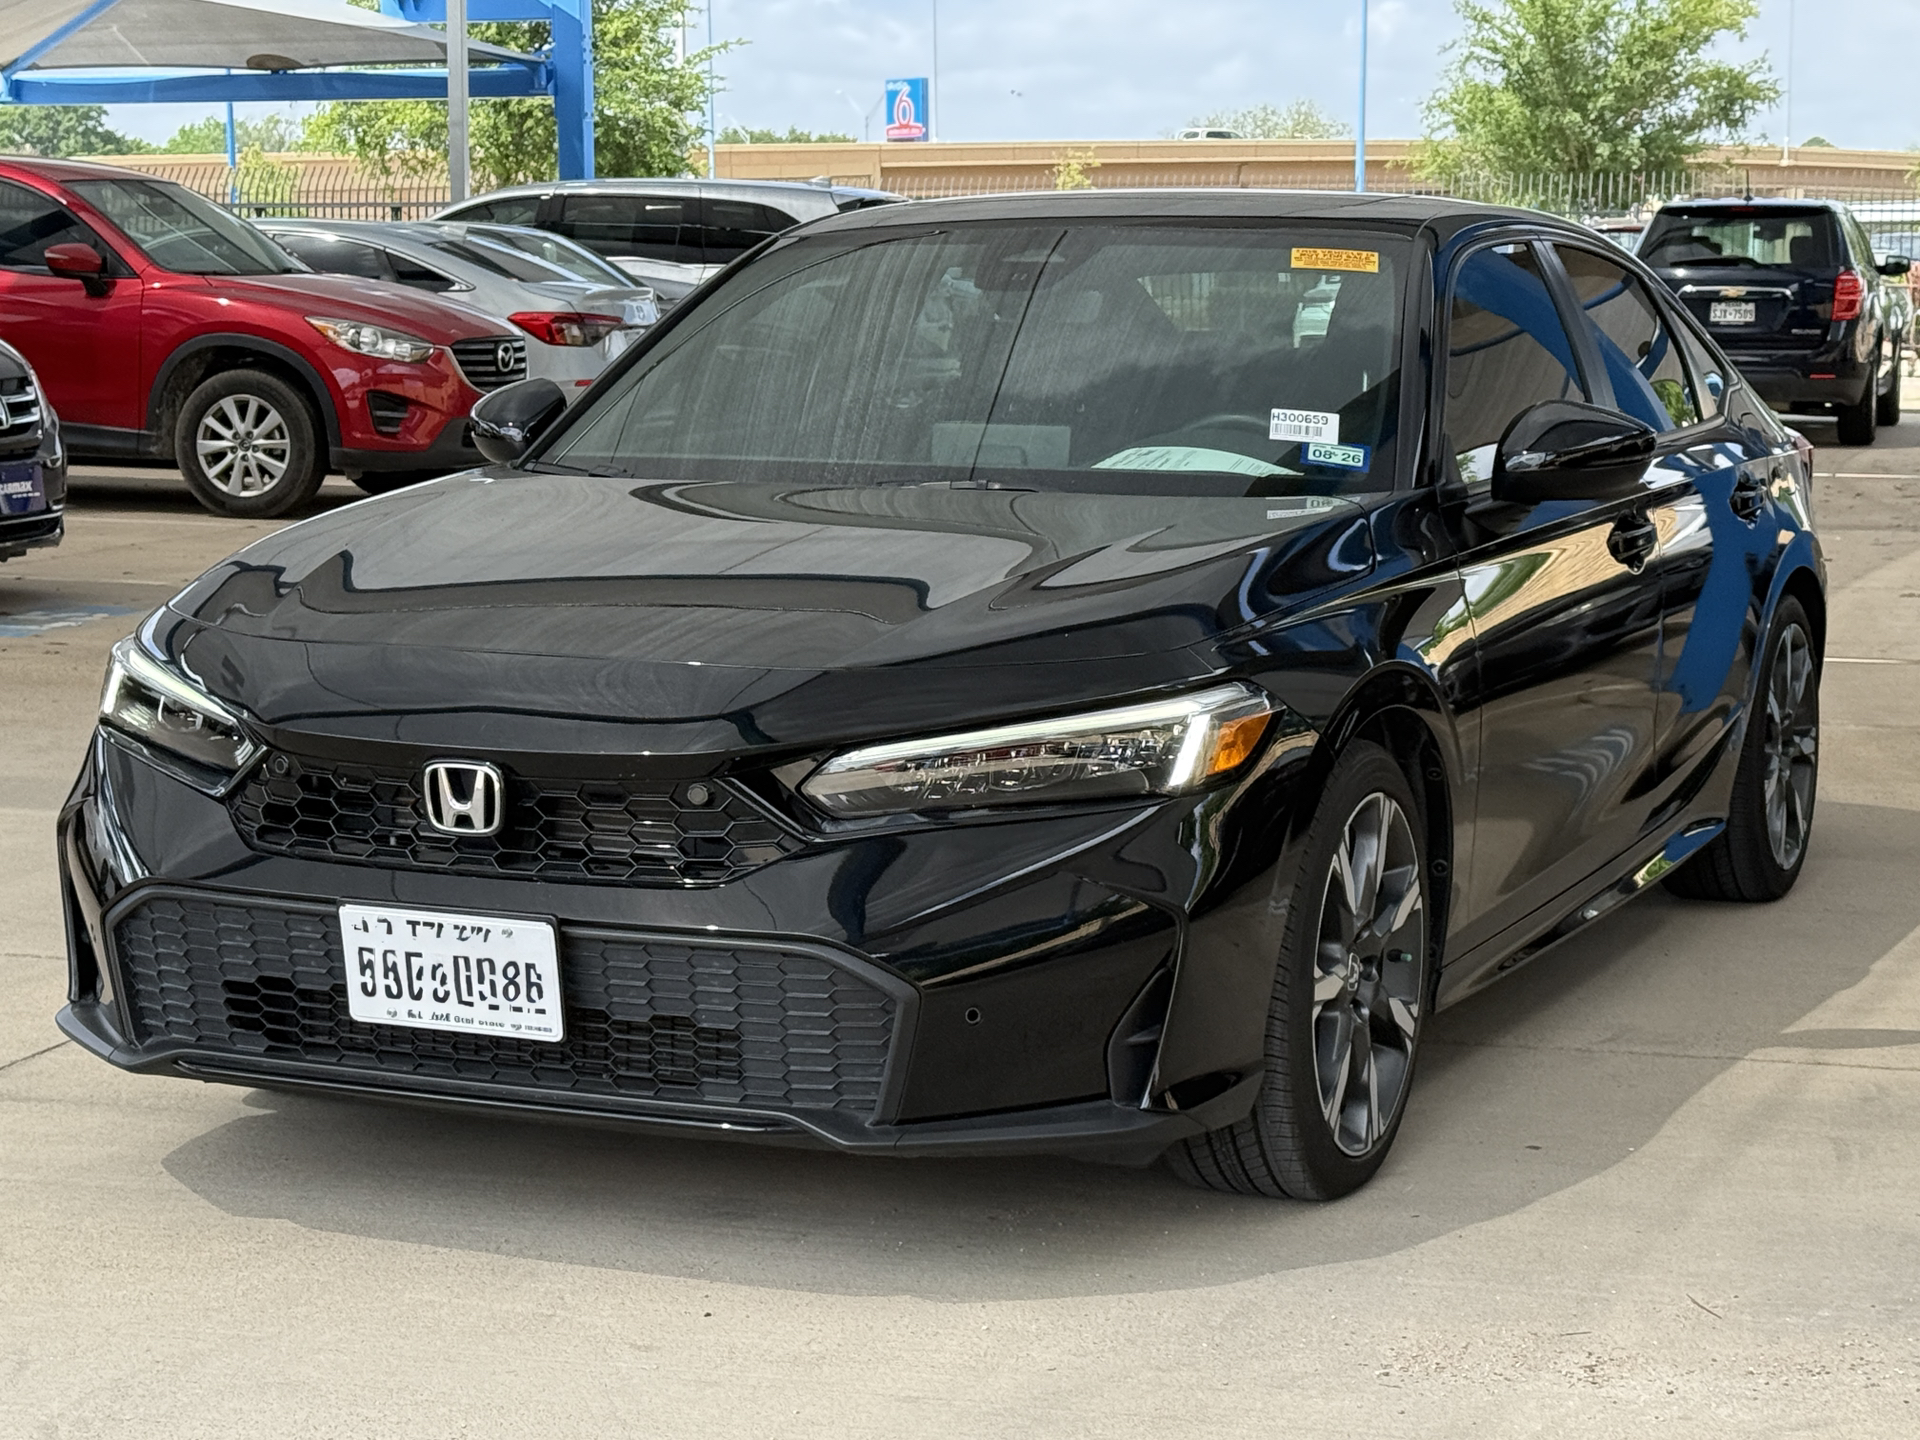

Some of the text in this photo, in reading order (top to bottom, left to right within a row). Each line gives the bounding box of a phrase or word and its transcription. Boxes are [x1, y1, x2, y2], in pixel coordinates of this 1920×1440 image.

[894, 86, 915, 127] 6
[1271, 412, 1329, 426] H300659
[1341, 452, 1362, 464] 26
